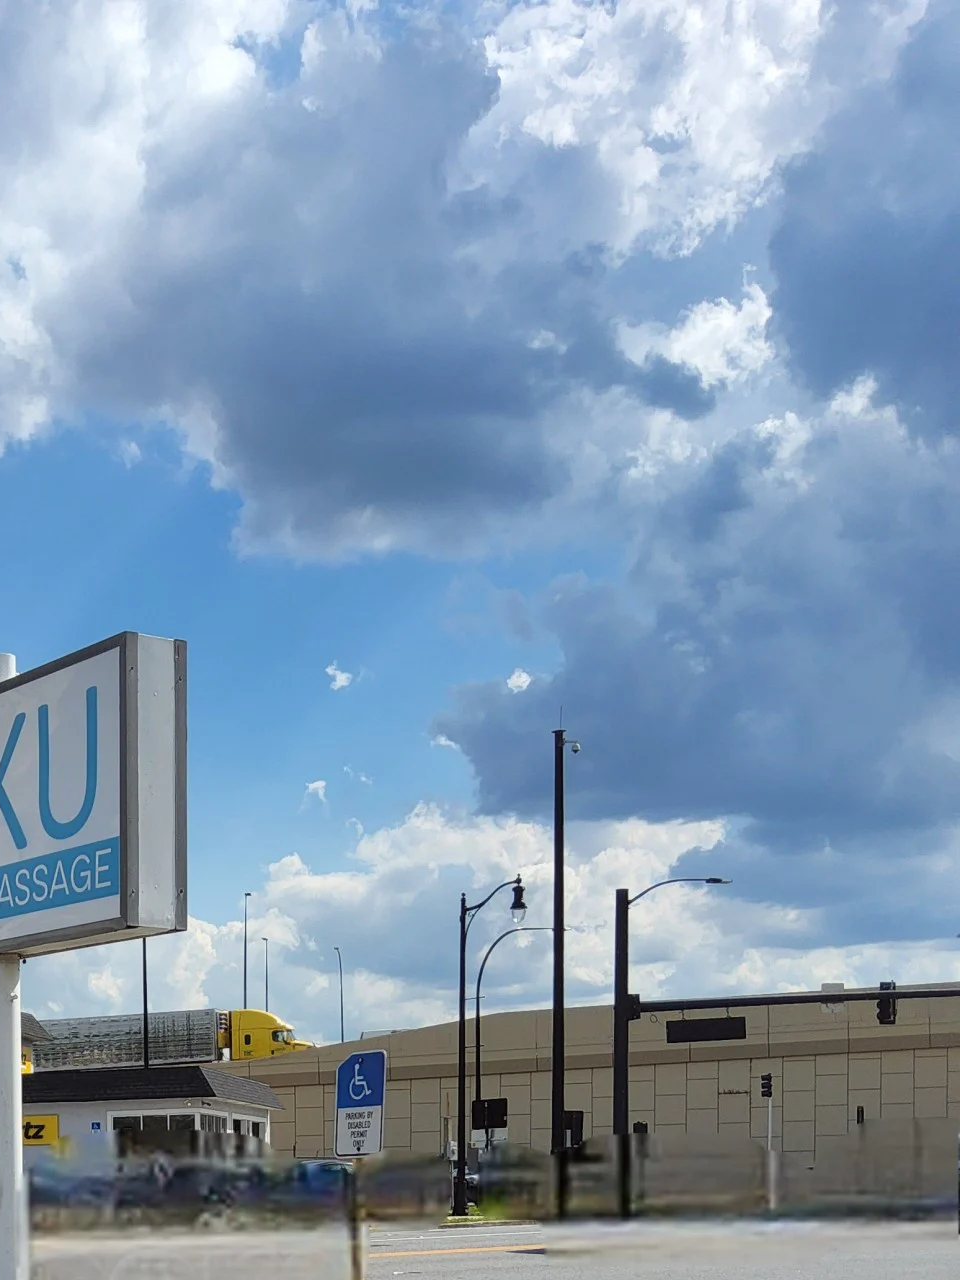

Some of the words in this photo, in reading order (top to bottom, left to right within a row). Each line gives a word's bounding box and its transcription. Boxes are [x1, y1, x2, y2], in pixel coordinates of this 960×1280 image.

[345, 1112, 366, 1120] PARKING
[366, 1111, 373, 1119] BY
[347, 1121, 371, 1130] DISABLED
[350, 1130, 368, 1139] PERMIT
[352, 1140, 365, 1148] ONLY
